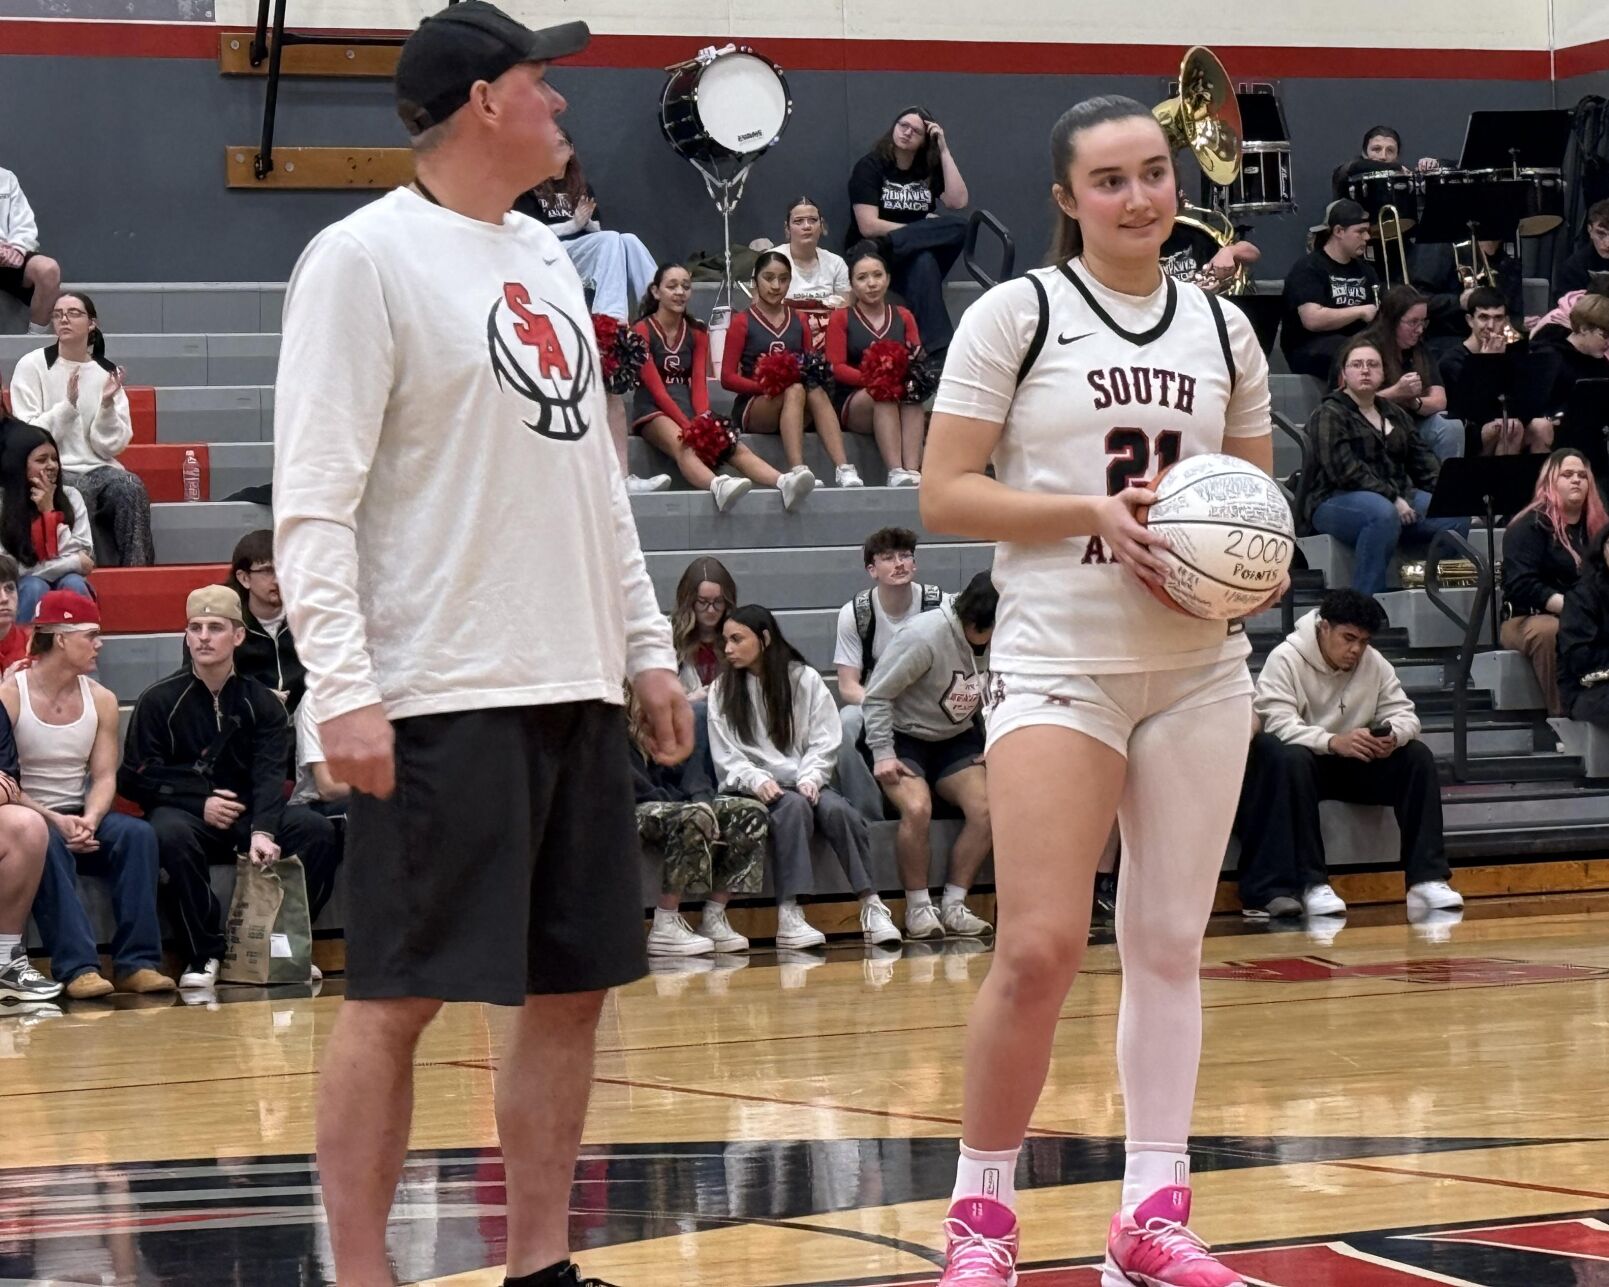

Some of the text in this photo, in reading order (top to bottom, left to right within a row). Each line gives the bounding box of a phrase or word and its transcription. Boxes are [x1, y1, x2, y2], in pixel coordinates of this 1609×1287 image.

[883, 201, 929, 211] BANDS
[503, 282, 572, 380] SA
[1087, 366, 1196, 415] SOUTH
[1104, 426, 1182, 497] 21
[1224, 530, 1288, 564] 2000
